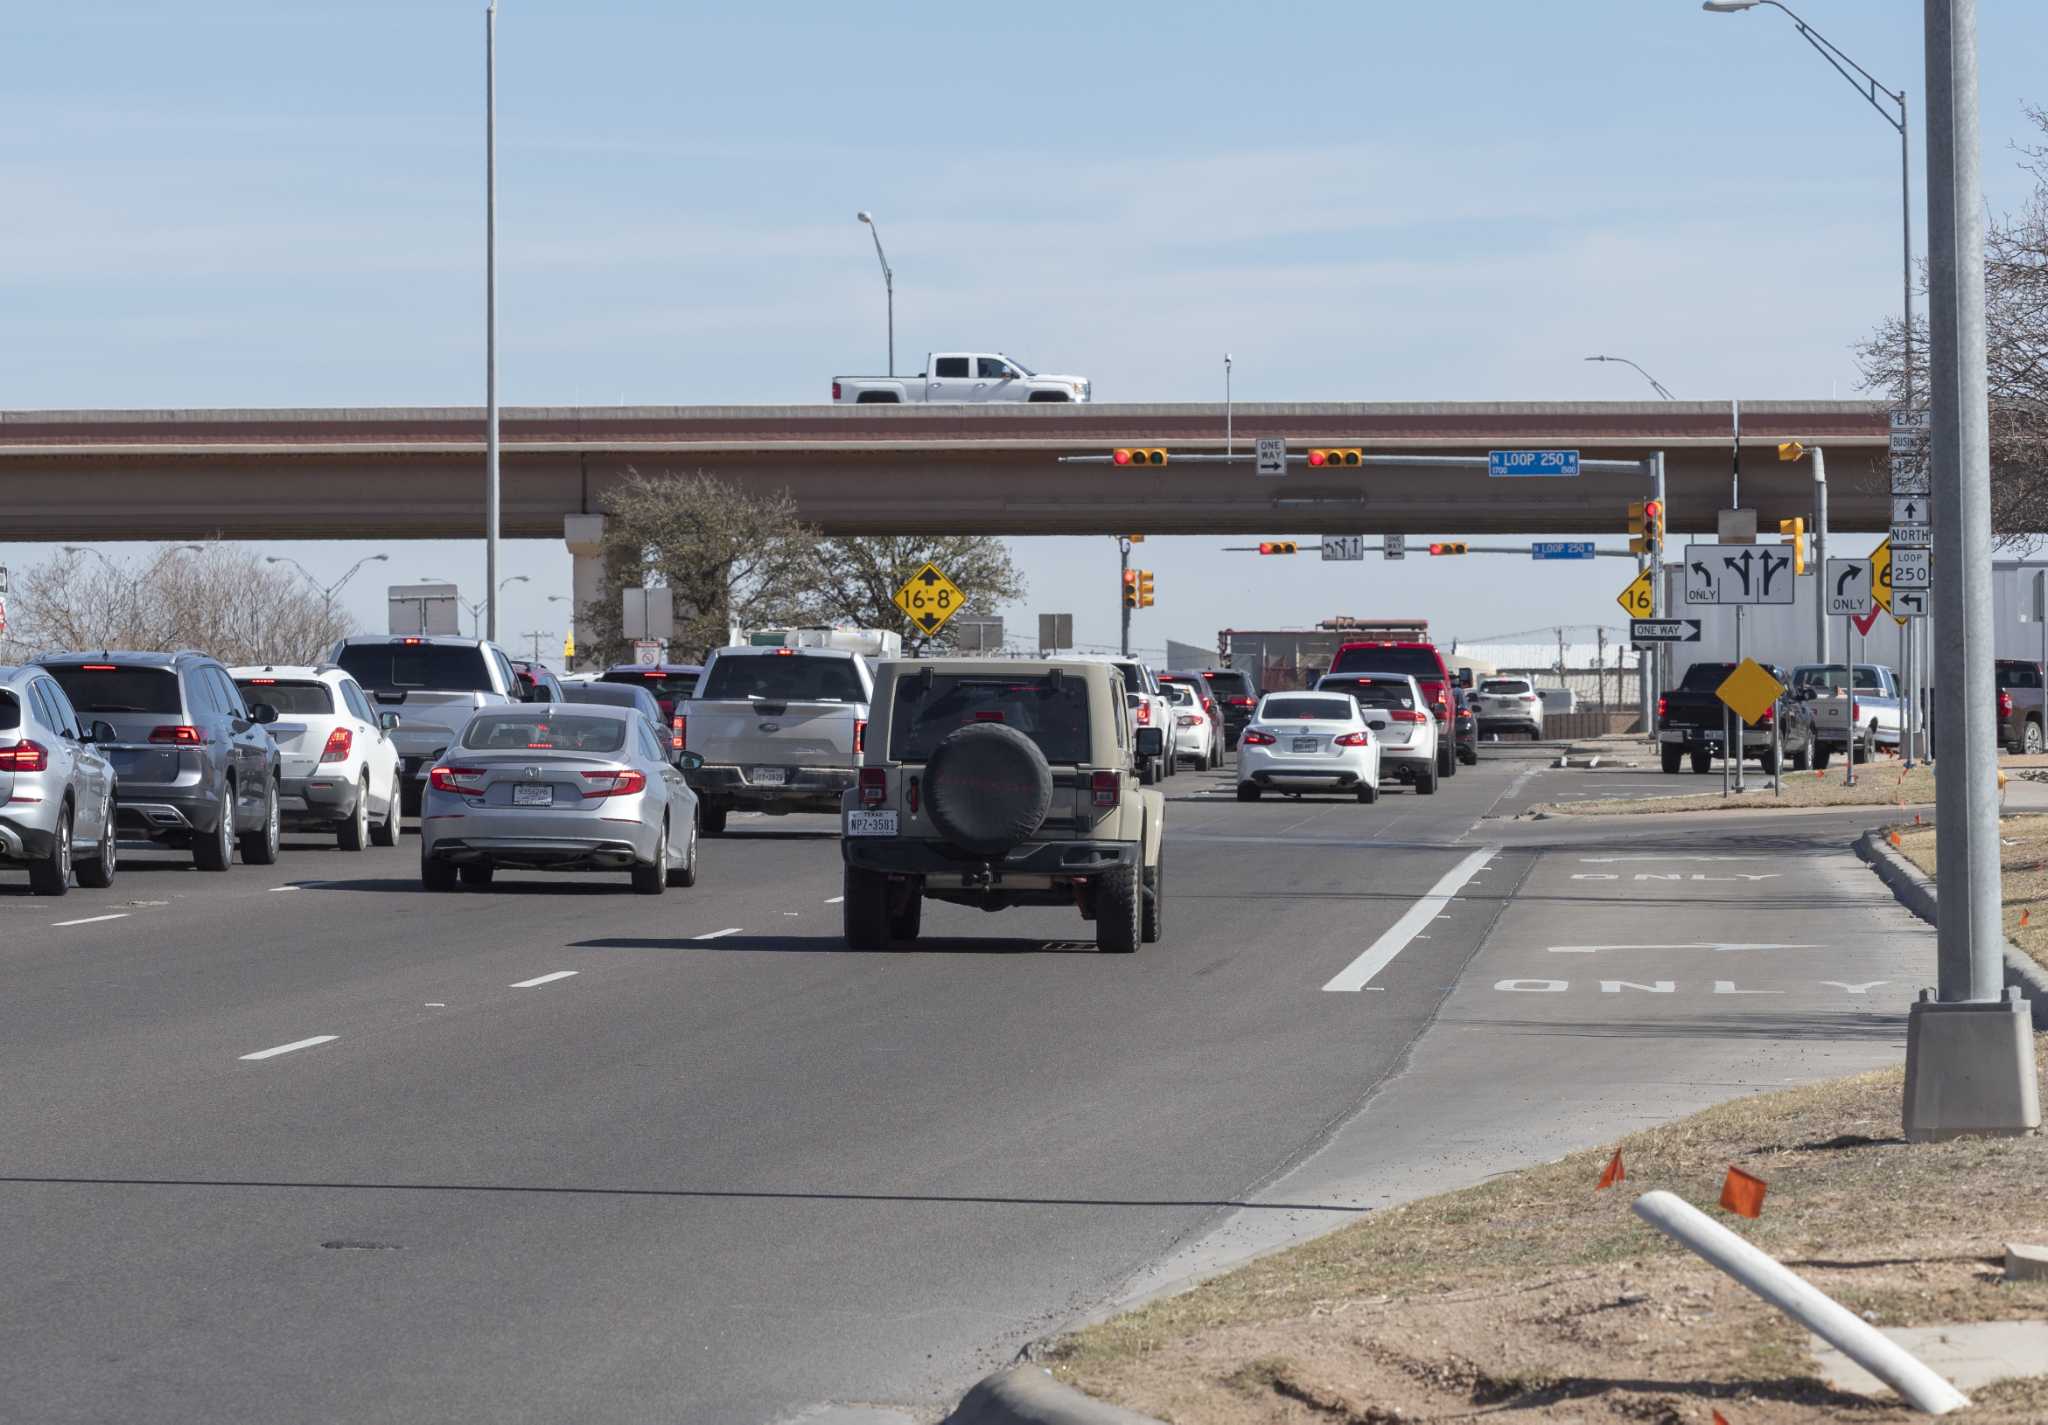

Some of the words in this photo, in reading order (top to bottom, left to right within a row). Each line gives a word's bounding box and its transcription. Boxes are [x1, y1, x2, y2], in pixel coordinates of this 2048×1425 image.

[1260, 441, 1280, 449] ONE
[1261, 451, 1281, 460] WAY
[1492, 455, 1499, 464] N
[1504, 453, 1535, 466] LOOP
[1541, 453, 1564, 466] 250
[1568, 455, 1576, 464] W
[1892, 529, 1929, 540] NORTH
[1542, 543, 1565, 552] LOOP
[1898, 553, 1922, 561] LOOP
[1895, 567, 1926, 580] 250
[1688, 590, 1716, 599] ONLY
[1833, 599, 1864, 609] ONLY
[1636, 625, 1656, 634] ONE
[1660, 625, 1680, 634] WAY
[1494, 979, 1891, 993] ONLY
